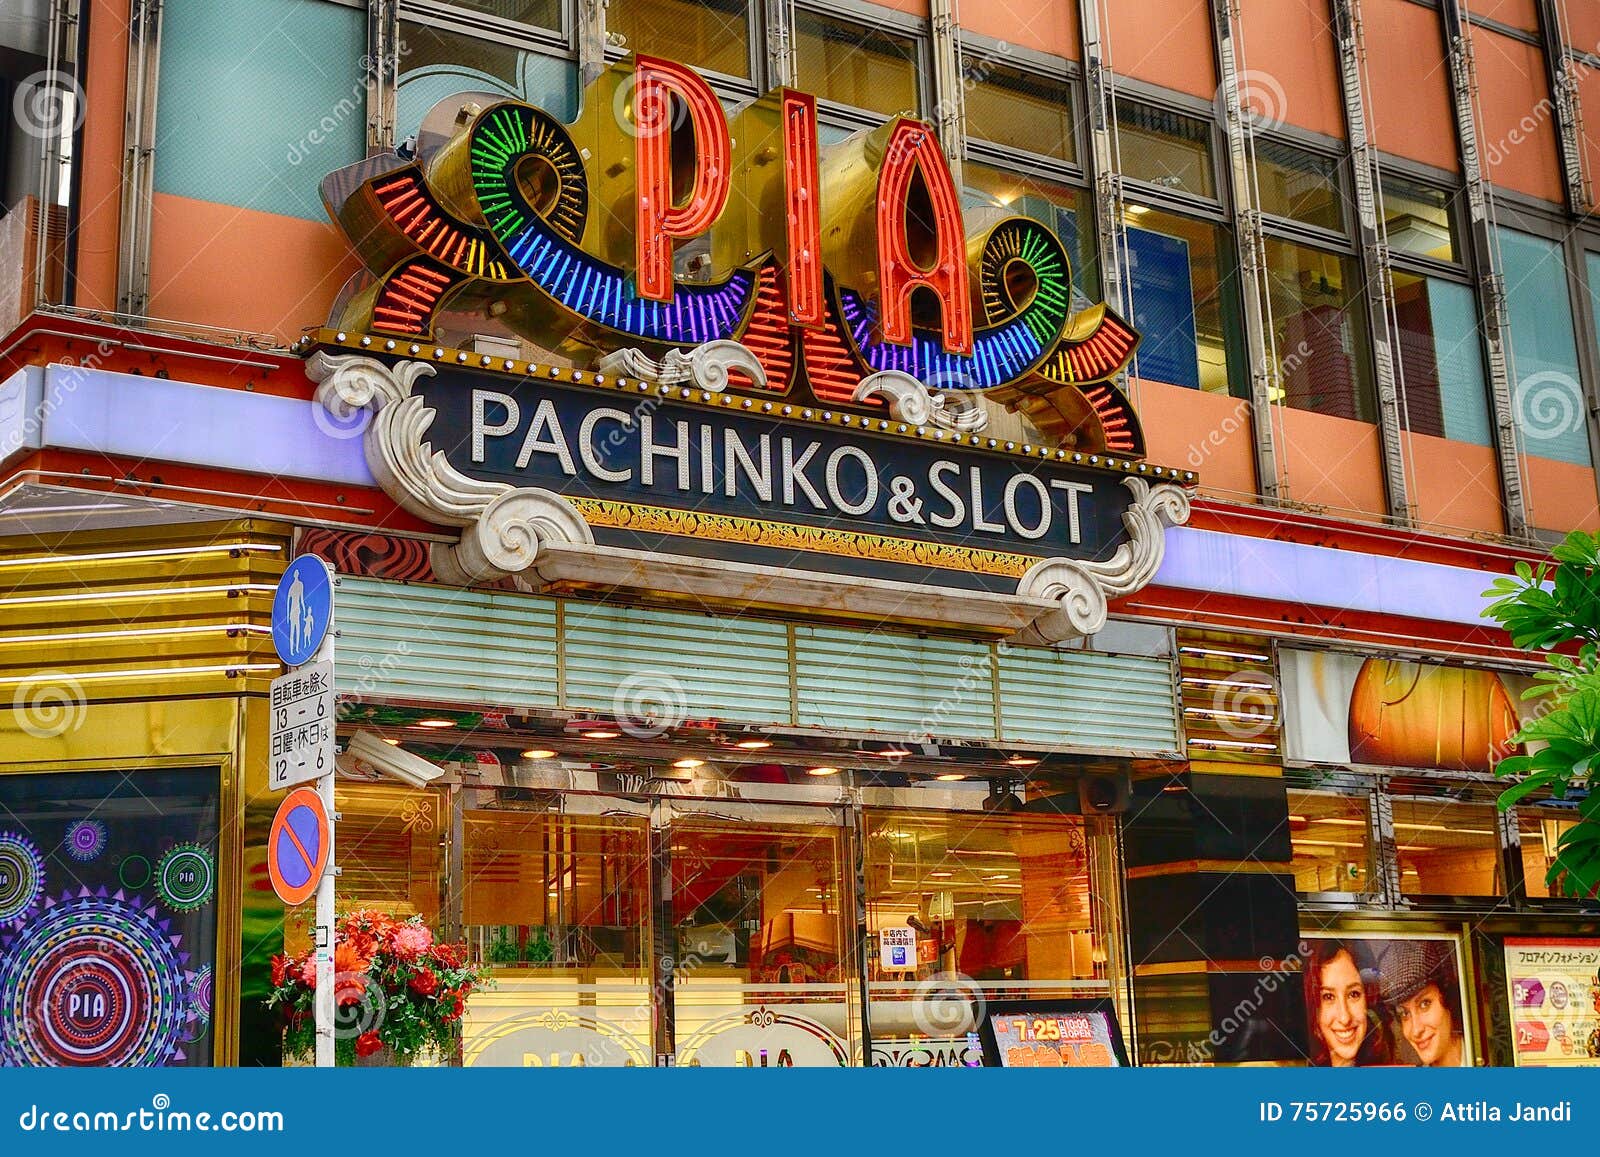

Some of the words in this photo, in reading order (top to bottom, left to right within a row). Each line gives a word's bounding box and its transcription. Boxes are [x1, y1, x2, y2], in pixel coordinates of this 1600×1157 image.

[635, 53, 973, 360] PIA
[273, 671, 328, 706] 自転車を除く
[276, 708, 288, 731] 13
[317, 696, 325, 717] 6
[276, 759, 287, 782] 12
[316, 748, 324, 769] 6
[179, 871, 195, 883] PIA
[1518, 951, 1599, 963] フロアインフォメーション
[69, 993, 105, 1018] PIA
